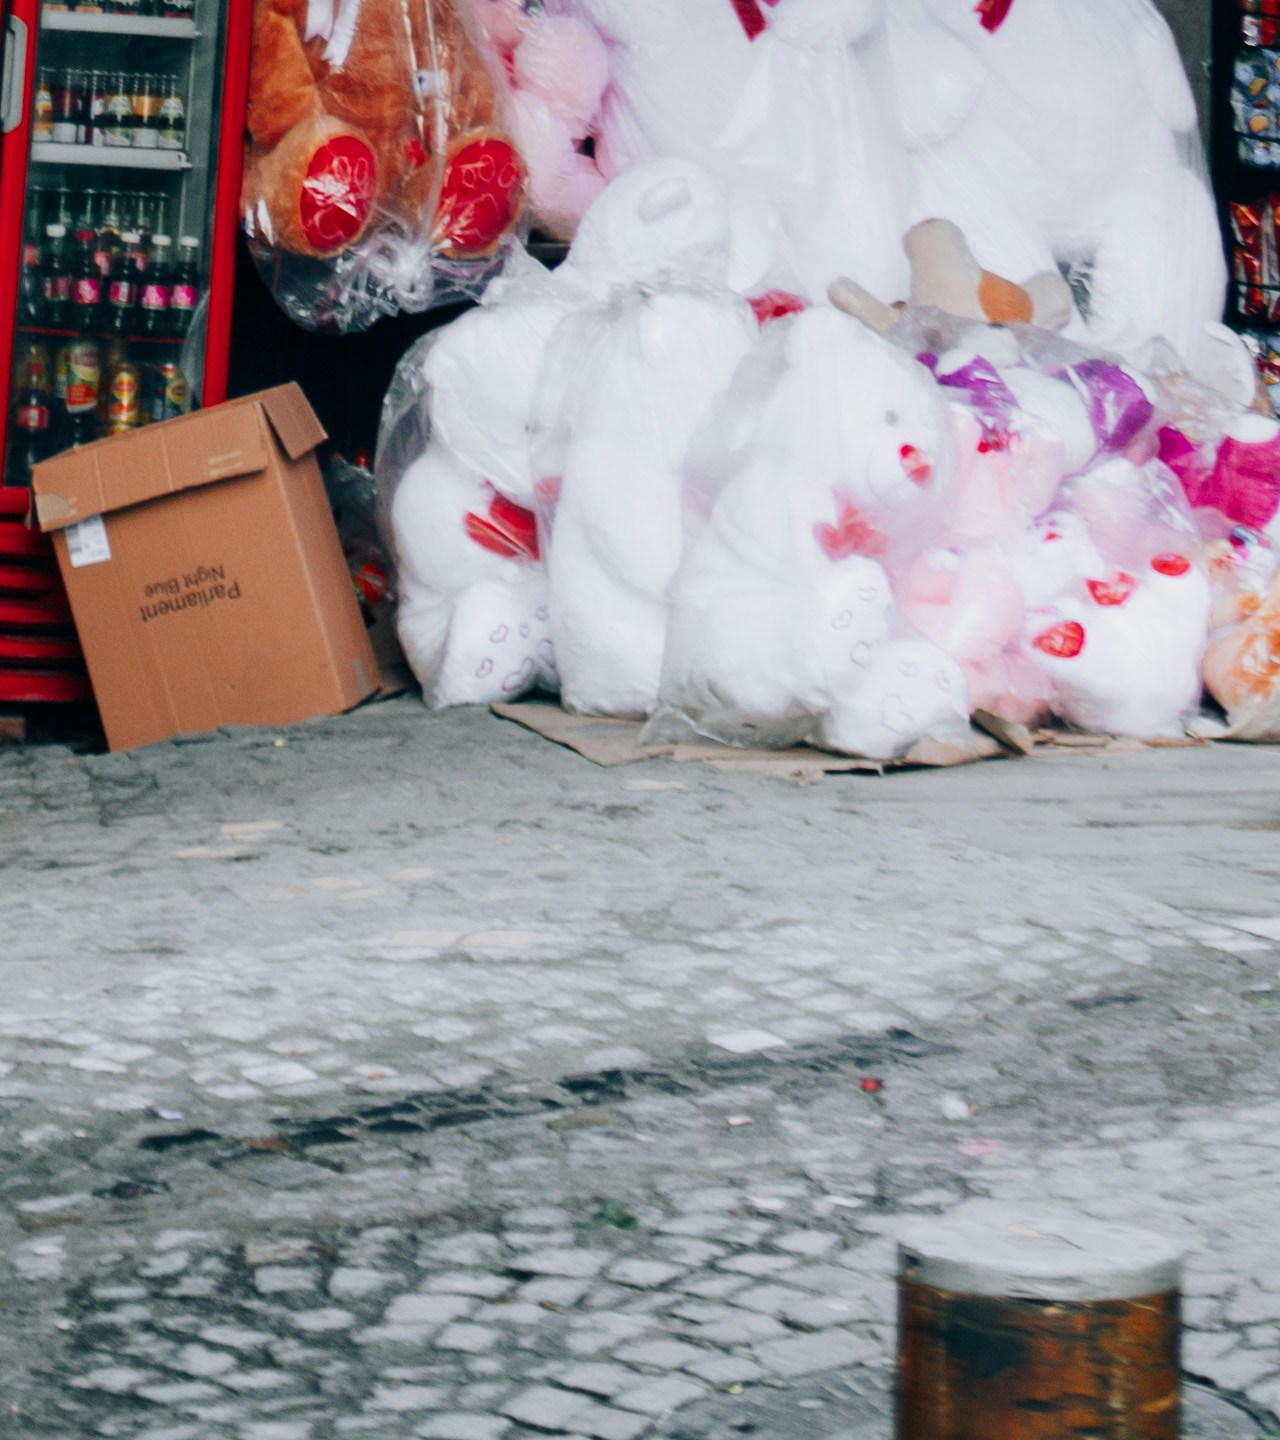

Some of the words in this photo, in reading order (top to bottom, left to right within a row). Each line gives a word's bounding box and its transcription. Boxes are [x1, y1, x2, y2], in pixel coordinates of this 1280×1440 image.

[144, 579, 180, 599] Blue
[183, 565, 225, 589] Night
[139, 581, 241, 622] Parliament
